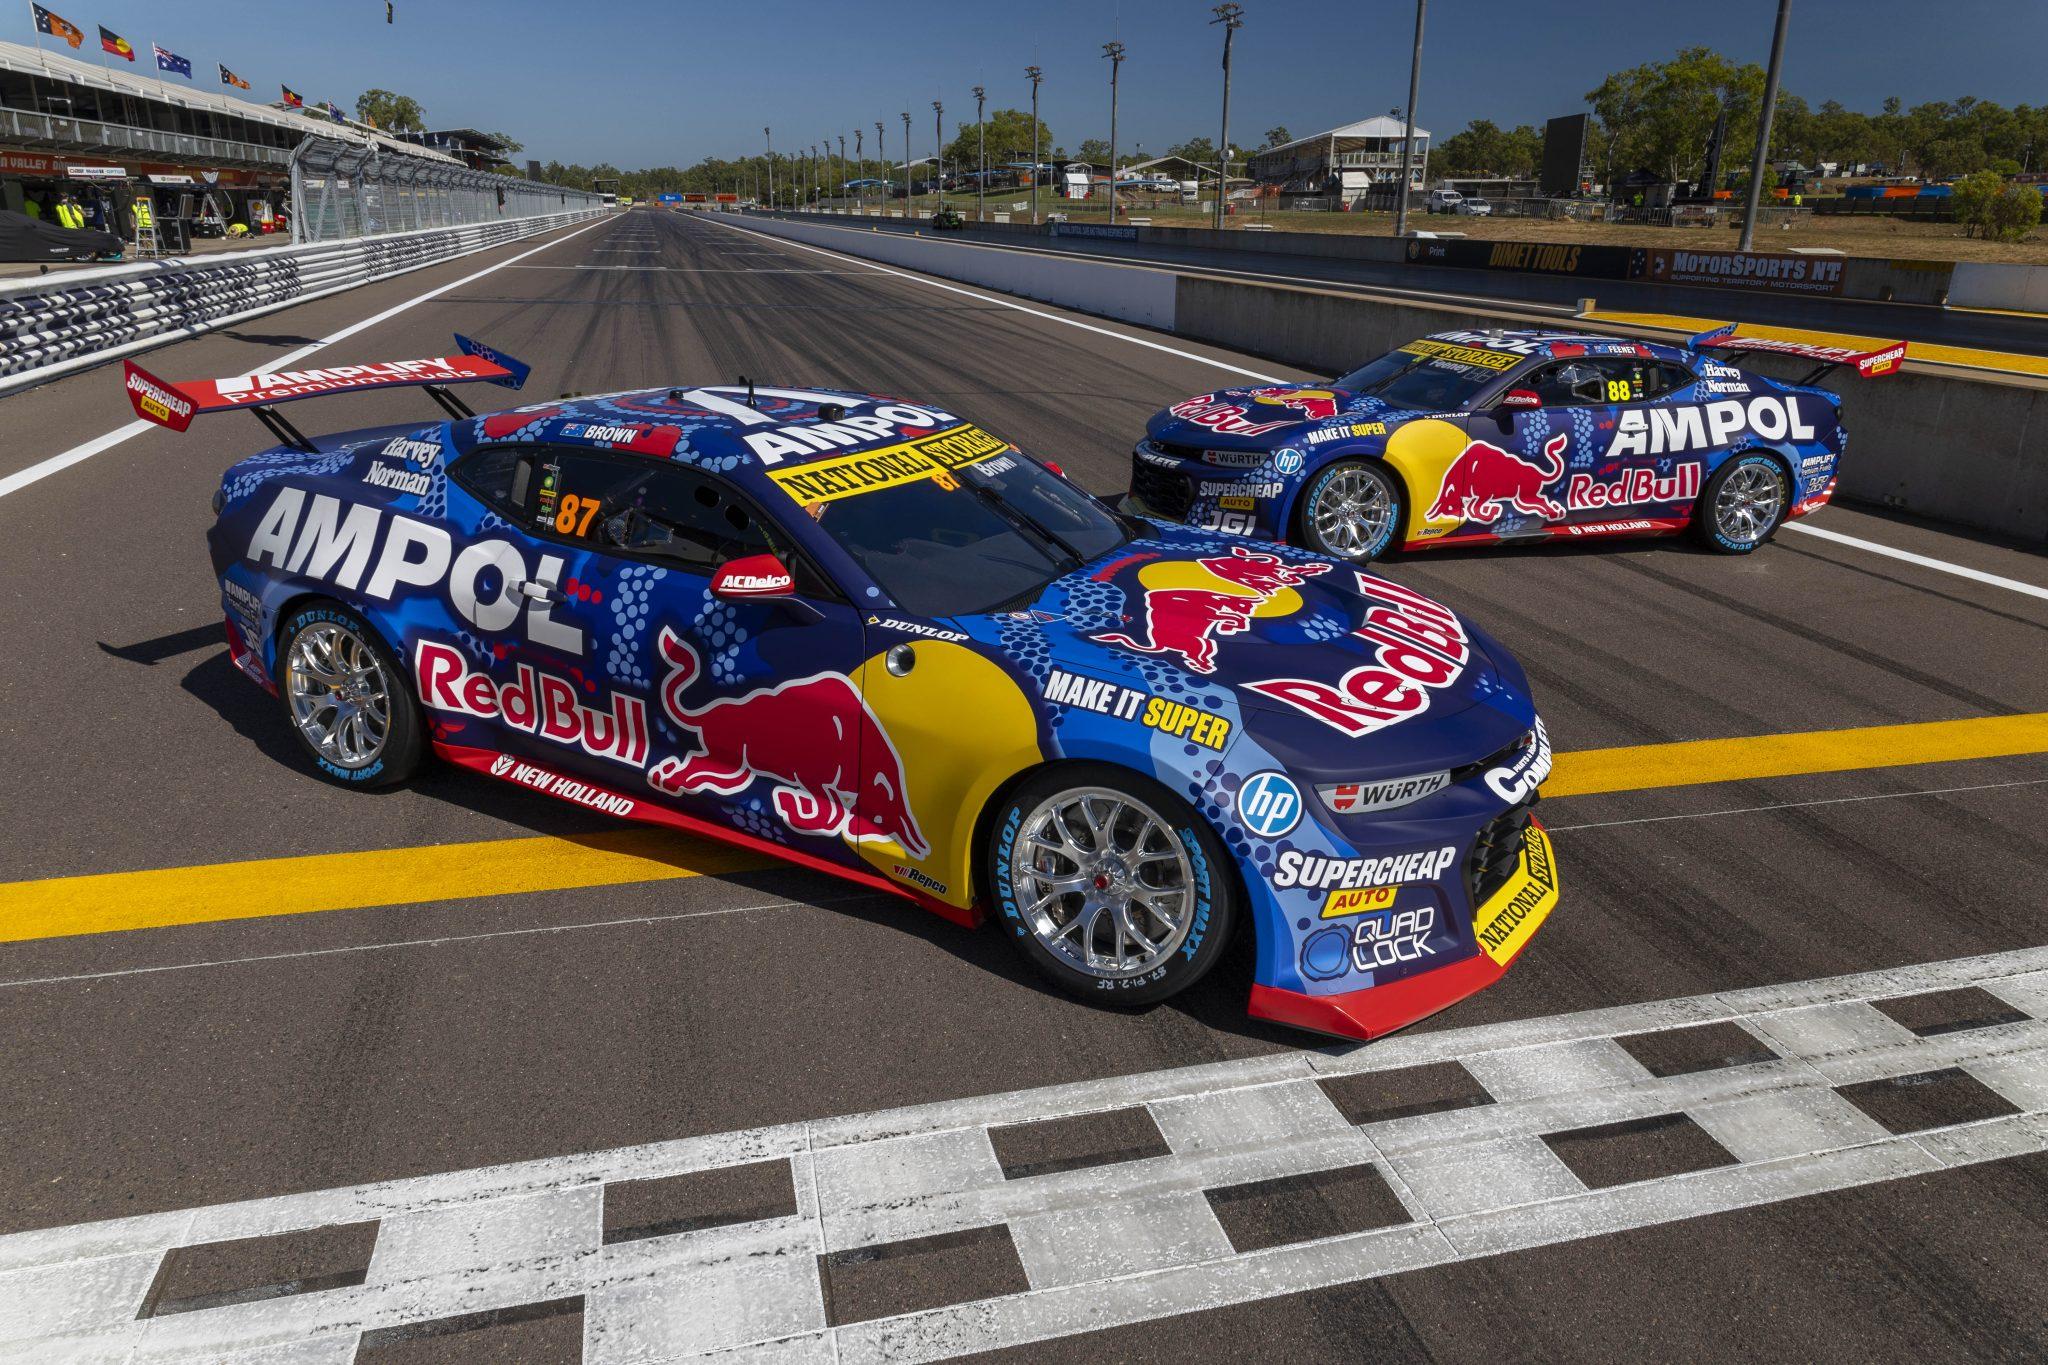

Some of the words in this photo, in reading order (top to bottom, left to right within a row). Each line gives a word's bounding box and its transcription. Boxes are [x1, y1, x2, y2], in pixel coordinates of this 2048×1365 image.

[10, 158, 48, 170] VALLEY
[1489, 243, 1535, 268] DIMET
[1533, 245, 1582, 272] TOOLS
[1671, 274, 1720, 284] SUPPORTING
[1722, 277, 1768, 287] TERRITORY
[1770, 281, 1836, 292] MOTORSPORT
[1440, 347, 1514, 368] STORAGE
[1607, 345, 1637, 355] FEENEY
[1859, 347, 1905, 370] SUPERCHEAP
[260, 357, 455, 389] AMPLIFY
[1429, 359, 1473, 373] Feeney
[1703, 363, 1741, 380] Harvey
[1873, 361, 1891, 372] AUTO
[127, 372, 192, 418] SUPERCHEAP
[222, 376, 389, 404] Premium
[393, 368, 478, 382] Fuels
[1607, 380, 1631, 401] 88
[1706, 379, 1751, 393] Norman
[144, 402, 167, 417] AUTO
[584, 425, 638, 443] BROWN
[742, 404, 957, 466] AMPOL
[1307, 427, 1340, 445] MAKE
[1339, 425, 1351, 438] IT
[1350, 422, 1387, 437] SUPER
[1605, 396, 1815, 458] AMPOL
[381, 436, 442, 469] Harvey
[778, 450, 936, 501] NATIONAL
[919, 427, 1009, 467] STORAGE
[1739, 457, 1763, 467] SPORT
[1805, 453, 1836, 467] AMPLIFY
[362, 461, 432, 496] Norman
[973, 456, 1018, 478] Brown
[931, 471, 961, 492] 87
[1200, 481, 1284, 498] SUPERCHEAP
[1308, 468, 1336, 518] DUNLOP
[1223, 498, 1251, 507] AUTO
[555, 494, 601, 537] 87
[1201, 510, 1257, 536] JGI
[1583, 523, 1605, 534] NEW
[1605, 520, 1652, 532] HOLLAND
[1715, 533, 1753, 550] DUNLOP
[246, 487, 585, 656] AMPOL
[720, 574, 792, 590] ACDelco
[296, 609, 360, 632] DUNLOP
[879, 618, 970, 643] DUNLOP
[1044, 669, 1117, 714] MAKE
[1114, 688, 1146, 720] IT
[1143, 697, 1231, 750] SUPER
[351, 758, 384, 781] SPORT
[510, 763, 552, 790] NEW
[549, 778, 635, 817] HOLLAND
[1363, 774, 1443, 806] WÜRTH
[998, 806, 1021, 920] DUNLOP
[1178, 827, 1211, 900] SPORT
[1273, 846, 1457, 890] SUPERCHEAP
[907, 867, 947, 895] Repco
[1331, 887, 1390, 911] AUTO
[1354, 906, 1435, 945] QUAD
[1479, 881, 1548, 953] NATIONAL
[1180, 898, 1211, 962] MAXX
[1352, 931, 1436, 971] LOCK
